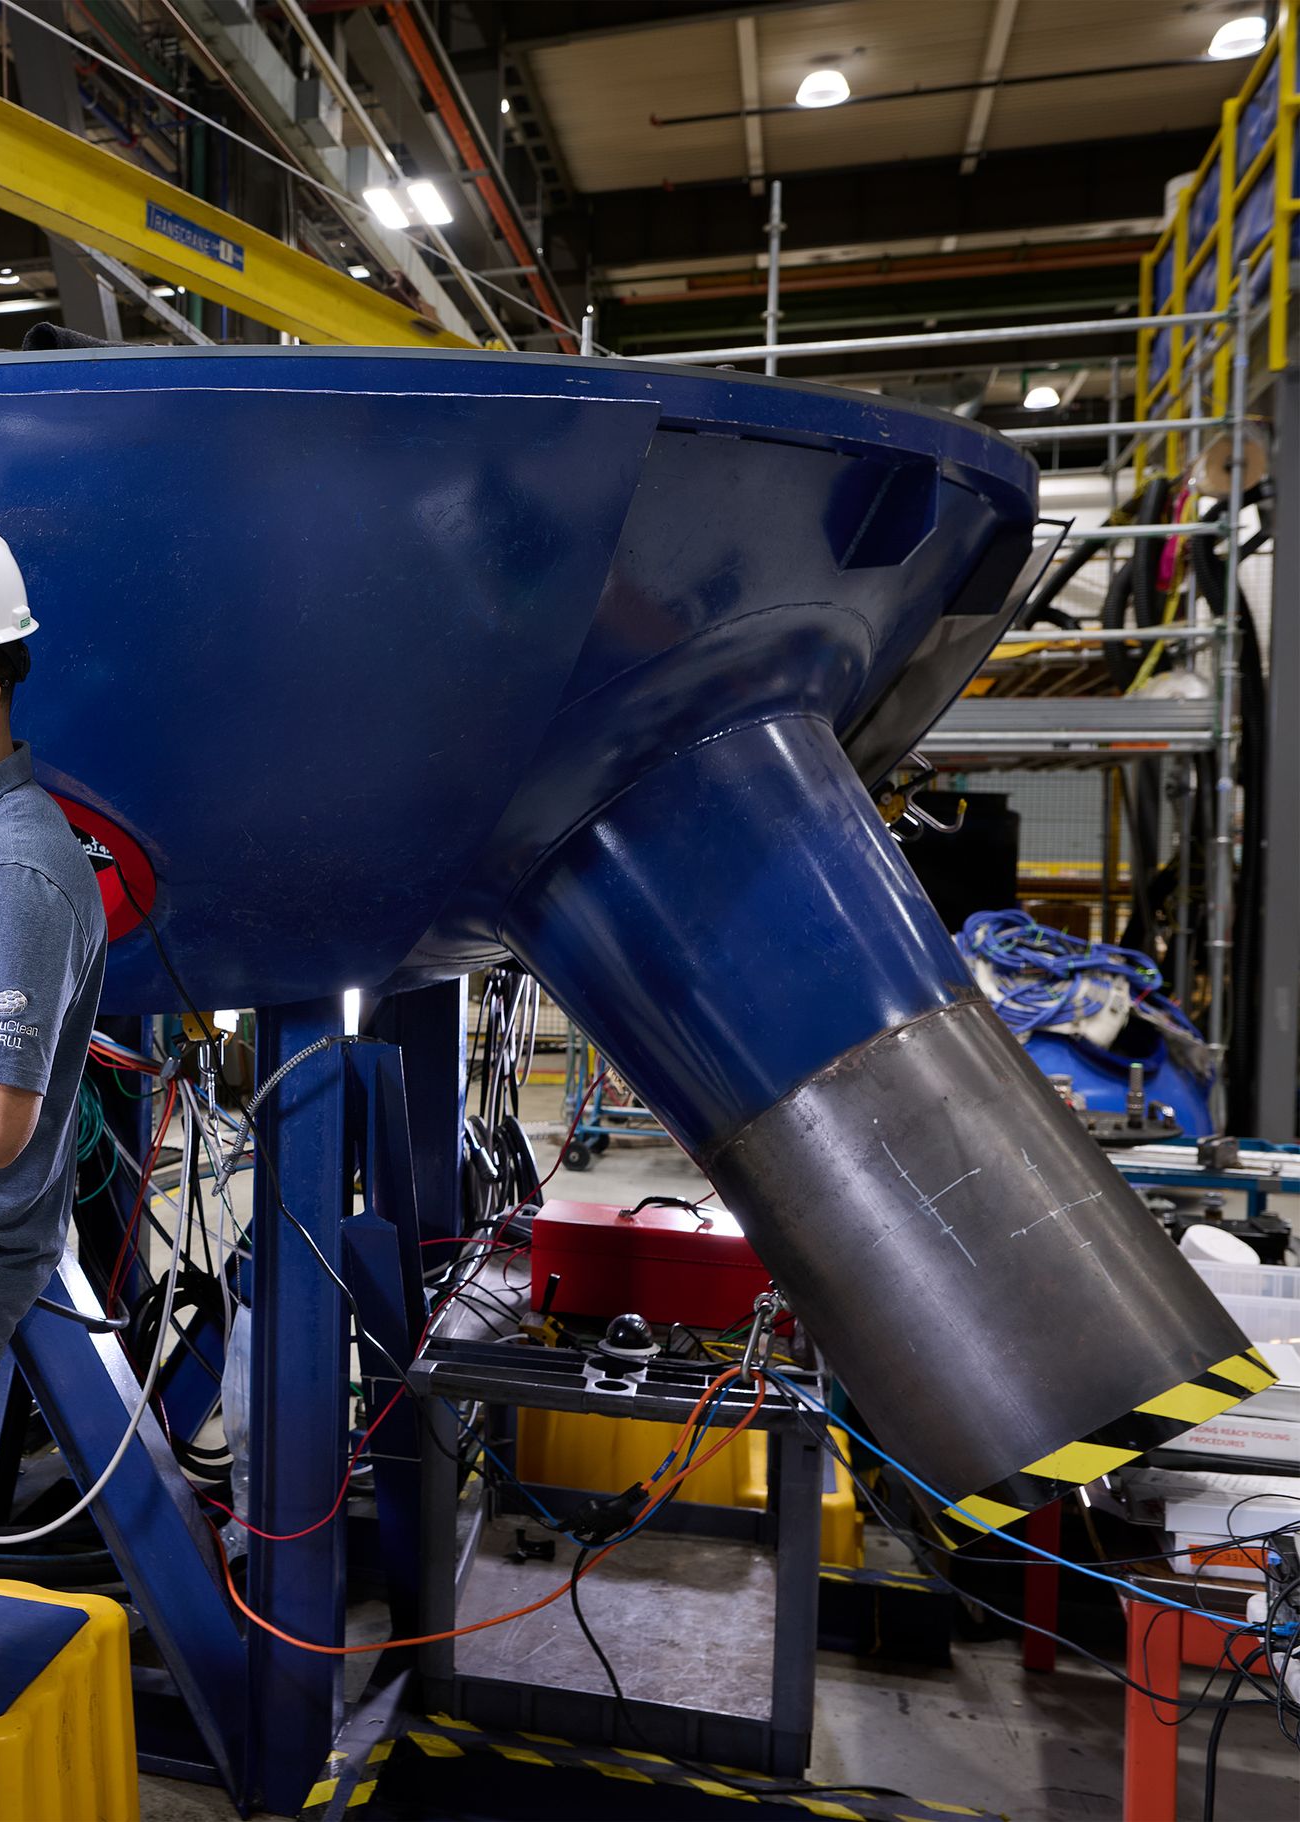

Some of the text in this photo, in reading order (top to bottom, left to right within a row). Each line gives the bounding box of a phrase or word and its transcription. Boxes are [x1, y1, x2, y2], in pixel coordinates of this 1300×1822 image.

[1220, 1428, 1249, 1438] REACH
[1251, 1431, 1291, 1441] TOOLING
[1189, 1436, 1245, 1448] PROCEDURES
